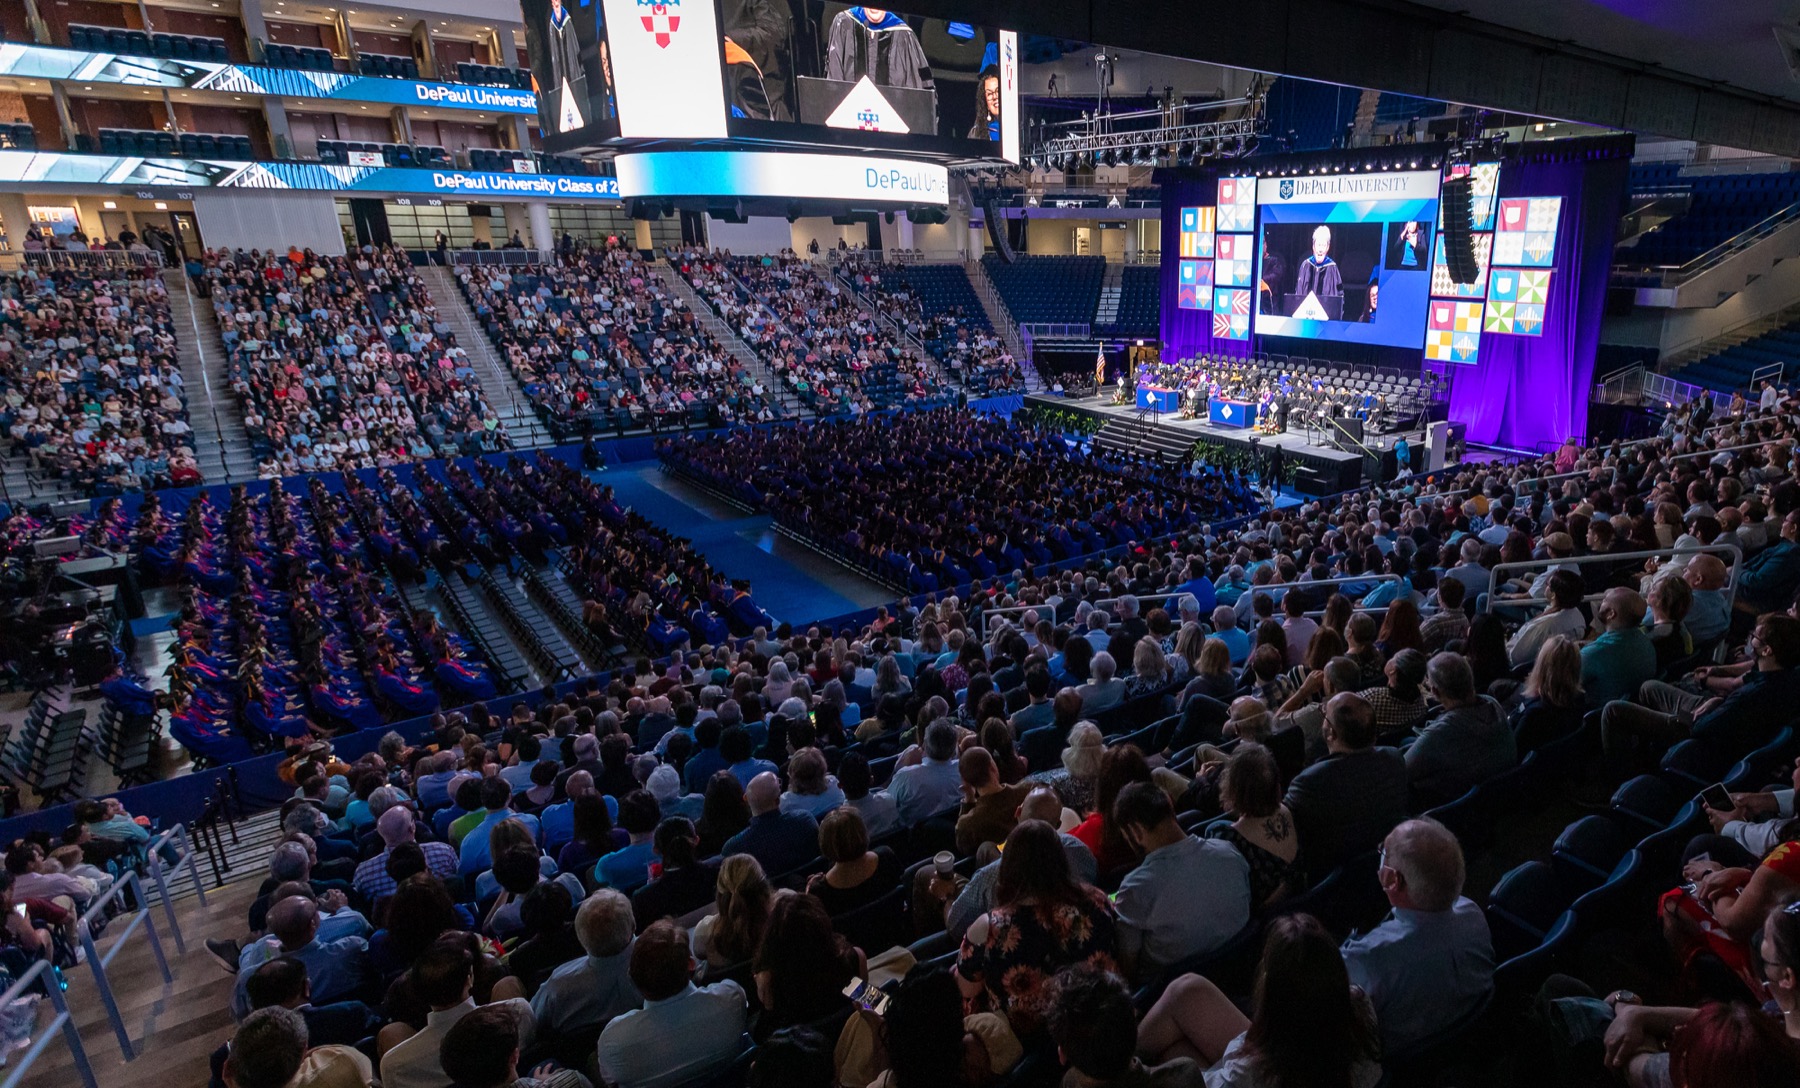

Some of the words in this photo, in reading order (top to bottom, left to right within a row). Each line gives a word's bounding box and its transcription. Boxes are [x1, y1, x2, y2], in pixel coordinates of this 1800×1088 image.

[415, 84, 473, 103] DePaul
[474, 88, 537, 108] Universit
[432, 172, 487, 190] DePaul
[488, 175, 556, 194] University
[557, 179, 594, 194] Class
[595, 180, 609, 194] of
[865, 167, 922, 190] DePaul
[1338, 176, 1410, 193] UNIVERSITY
[136, 191, 154, 200] 106
[177, 192, 193, 200] 107
[396, 198, 411, 206] 108
